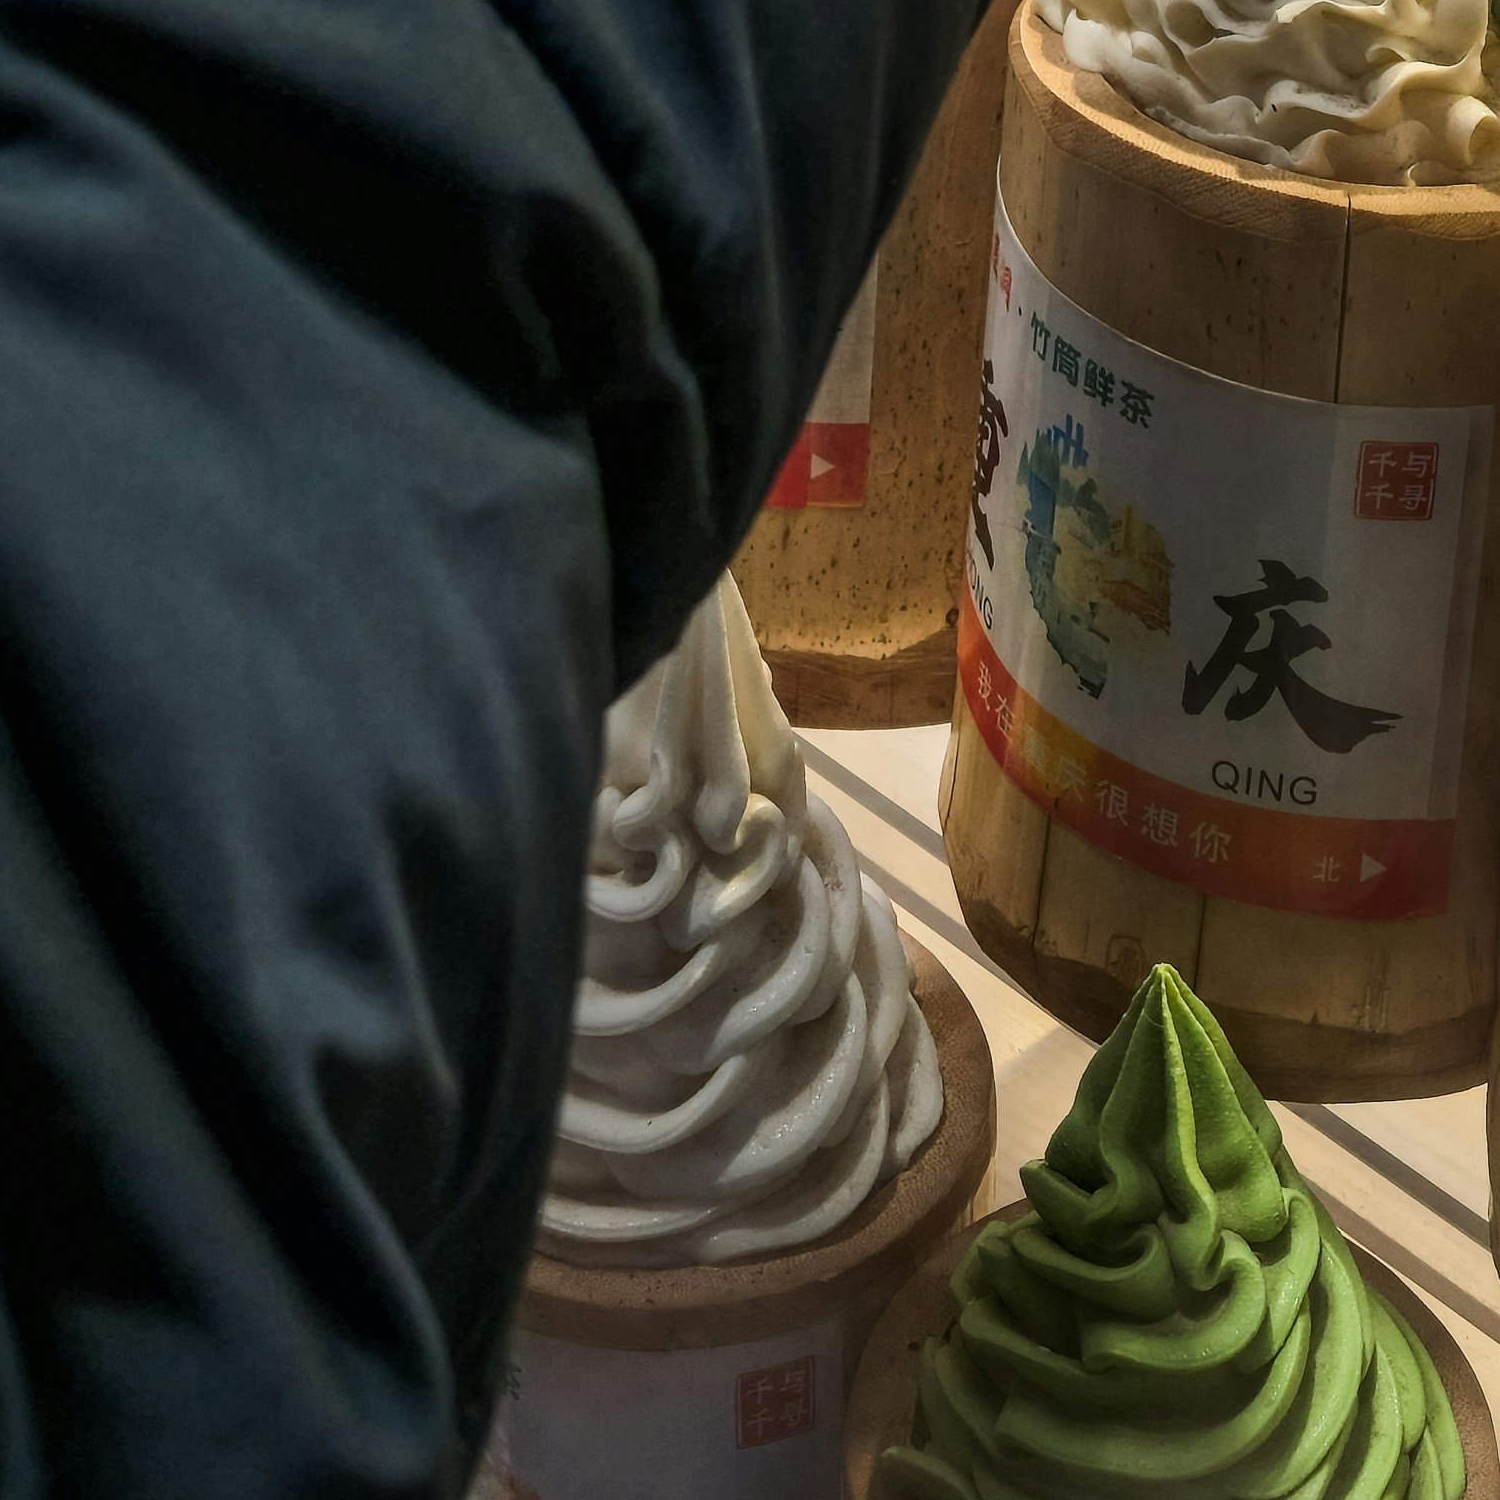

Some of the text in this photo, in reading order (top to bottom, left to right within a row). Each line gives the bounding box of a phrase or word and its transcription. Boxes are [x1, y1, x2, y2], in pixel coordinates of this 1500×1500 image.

[1029, 310, 1156, 430] 竹筒鲜茶
[1181, 559, 1406, 754] 庆
[1209, 759, 1320, 807] QING
[1312, 854, 1341, 883] 北
